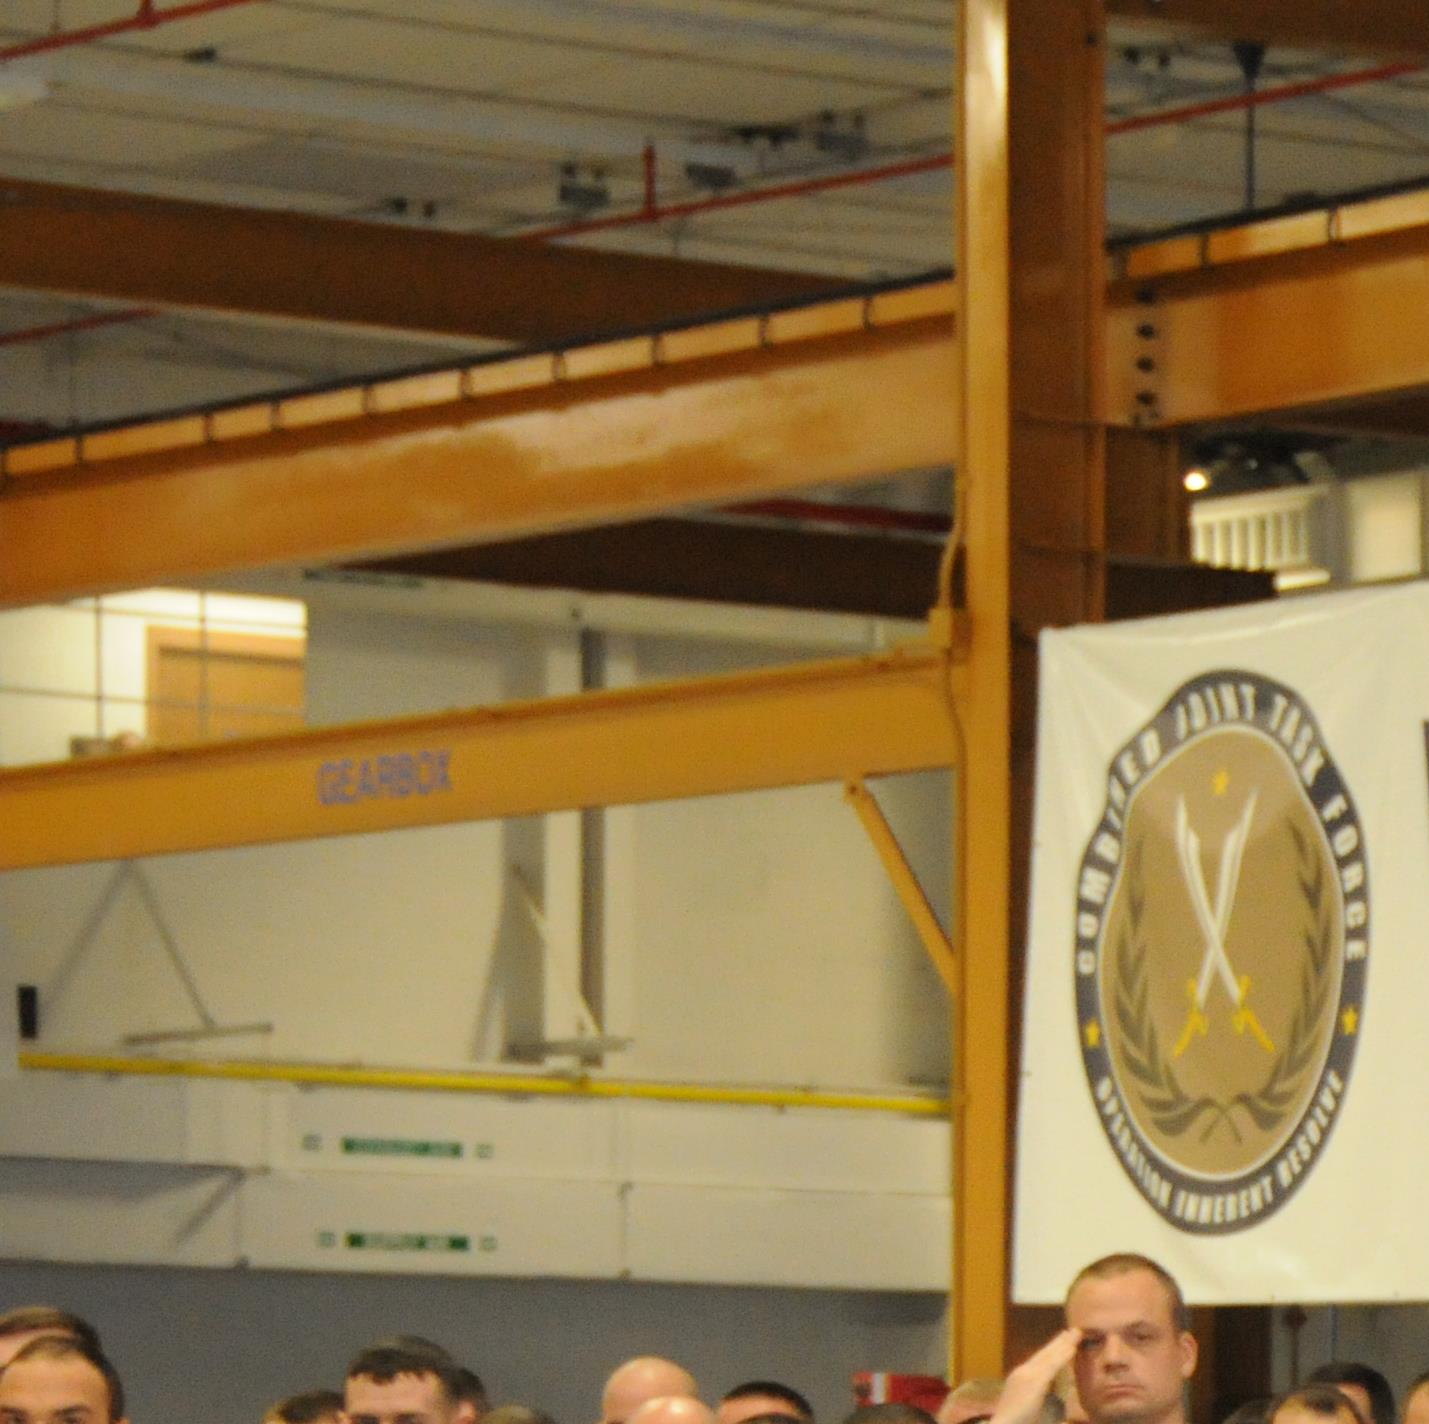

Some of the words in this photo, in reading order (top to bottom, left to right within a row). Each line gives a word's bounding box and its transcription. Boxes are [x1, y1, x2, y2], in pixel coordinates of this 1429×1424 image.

[317, 749, 452, 806] GEARBOX
[1077, 728, 1161, 976] COMBINED
[1174, 682, 1256, 740] JOINT
[1268, 692, 1325, 788] TASK
[1322, 793, 1367, 961] FORCE
[1275, 1069, 1344, 1188] RESOLVE
